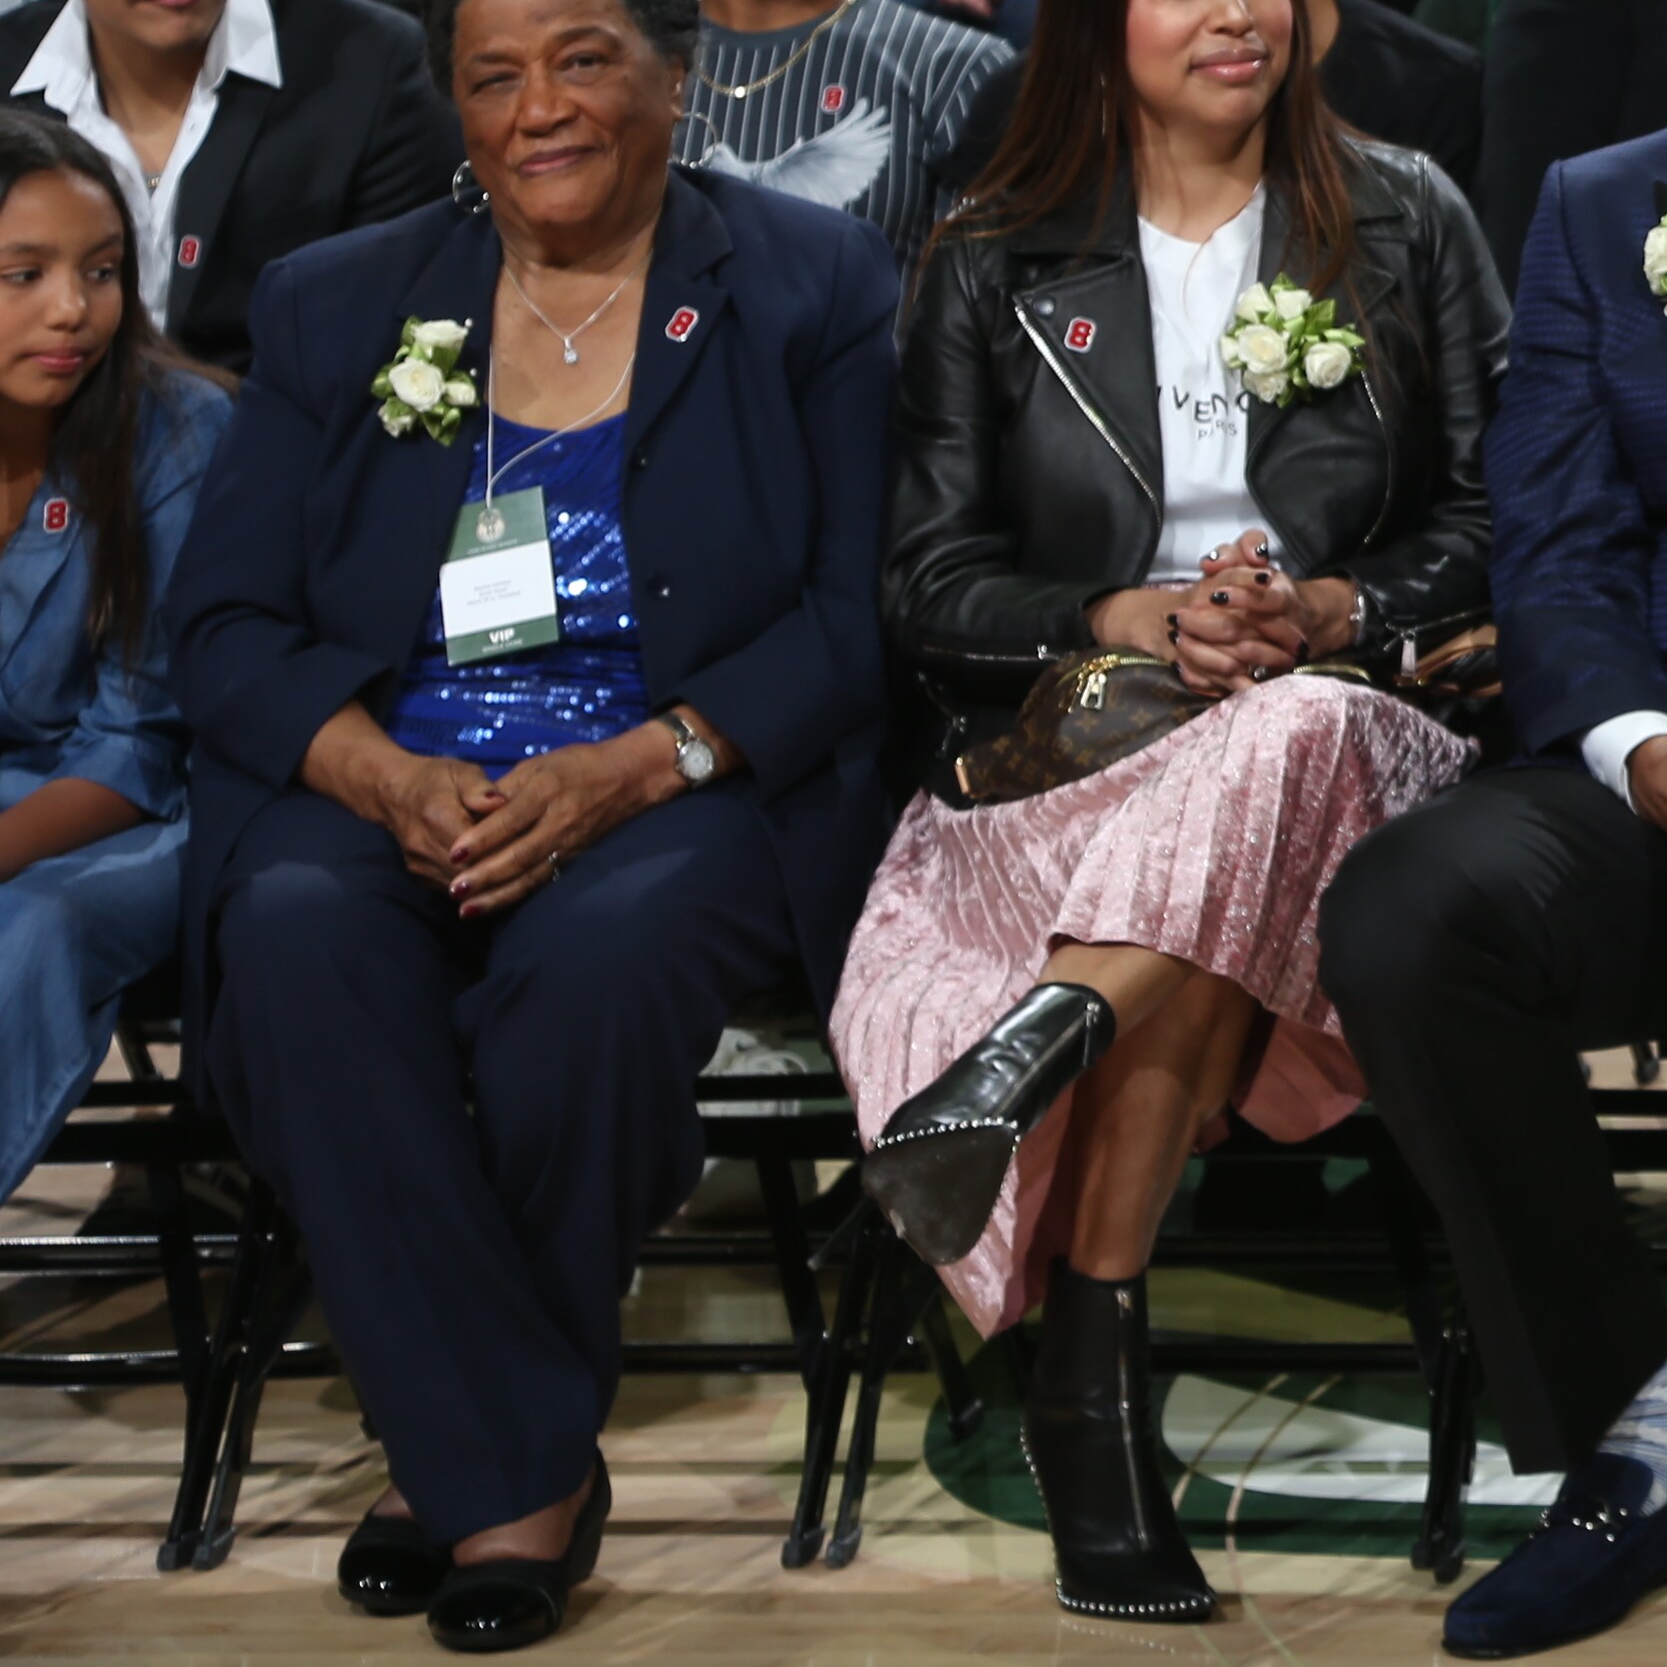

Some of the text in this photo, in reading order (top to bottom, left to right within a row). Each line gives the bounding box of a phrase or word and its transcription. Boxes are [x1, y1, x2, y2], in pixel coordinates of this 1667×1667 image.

[178, 234, 202, 268] 8
[665, 306, 700, 342] 8
[1064, 316, 1097, 353] 8
[44, 497, 69, 533] 8
[488, 626, 516, 644] VIP
